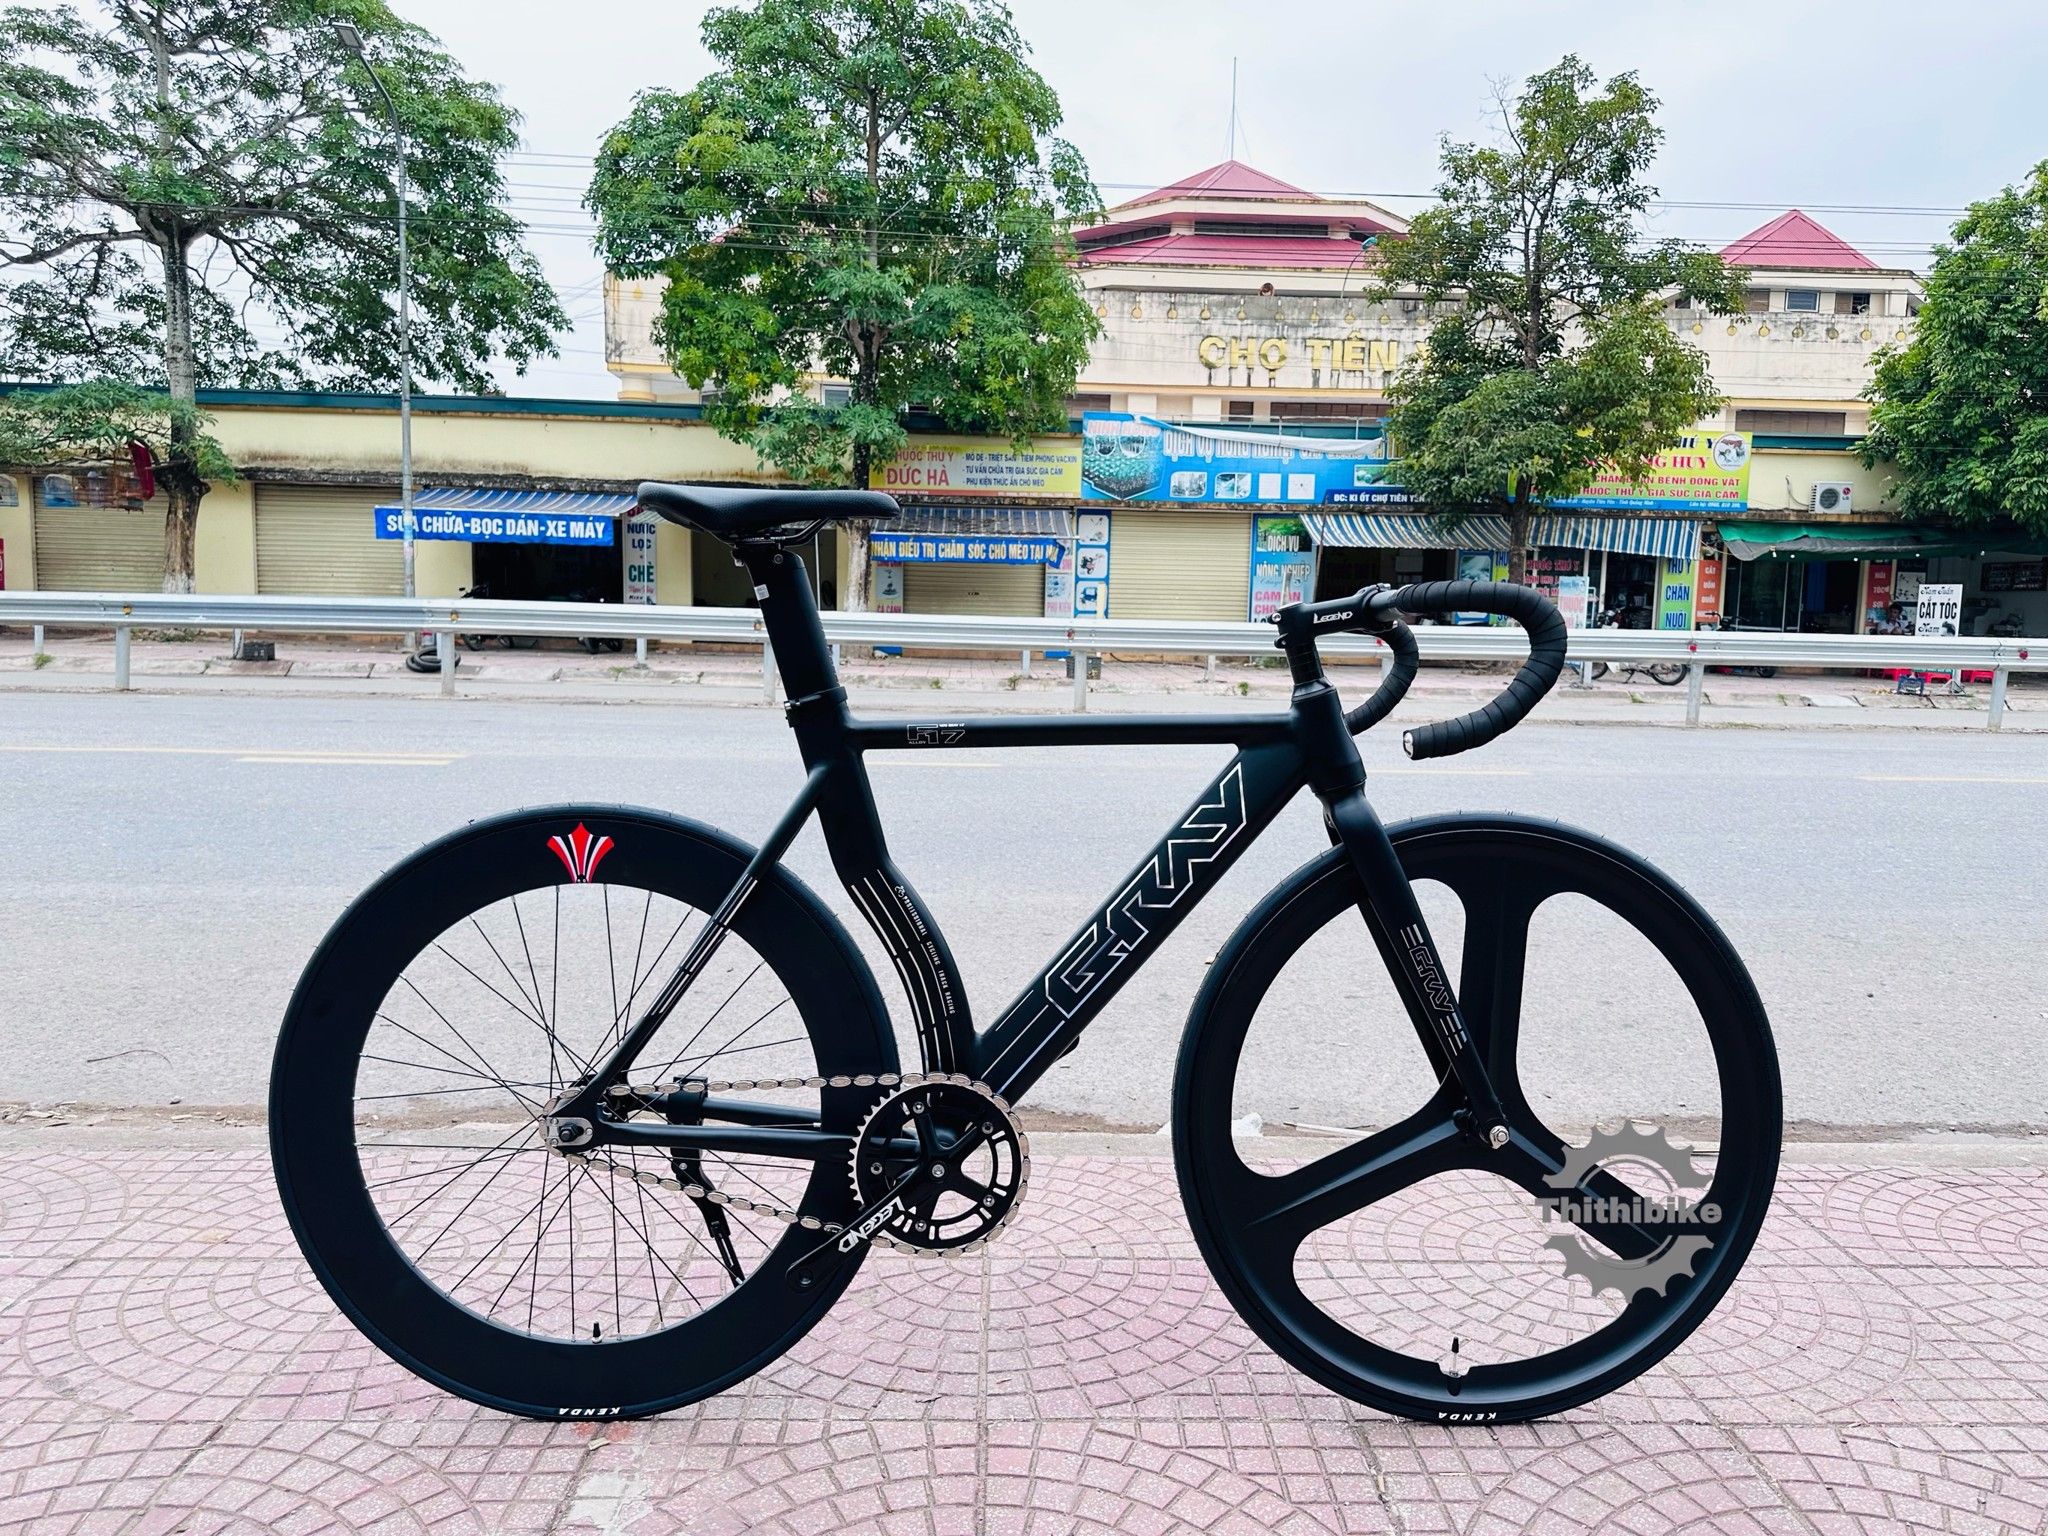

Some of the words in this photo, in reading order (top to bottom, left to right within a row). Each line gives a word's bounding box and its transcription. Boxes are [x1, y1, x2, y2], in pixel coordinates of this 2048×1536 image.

[1199, 335, 1288, 379] CHỢ
[1305, 330, 1398, 373] TIÊN
[887, 463, 922, 486] ĐỨC
[927, 464, 949, 486] HÀ
[1349, 494, 1358, 503] KI
[1693, 490, 1712, 499] GIA
[569, 516, 606, 539] MÁY
[938, 539, 965, 559] CHĂM
[968, 540, 986, 560] SÓC
[988, 540, 1007, 560] CHÓ
[1029, 544, 1044, 563] TẠI
[1313, 611, 1353, 624] LEGEND
[1919, 596, 1937, 619] CẮT
[1939, 598, 1958, 619] TÓC
[838, 1195, 905, 1253] LEGEND
[559, 1406, 621, 1416] KENDA
[1438, 1412, 1497, 1421] KENDA
